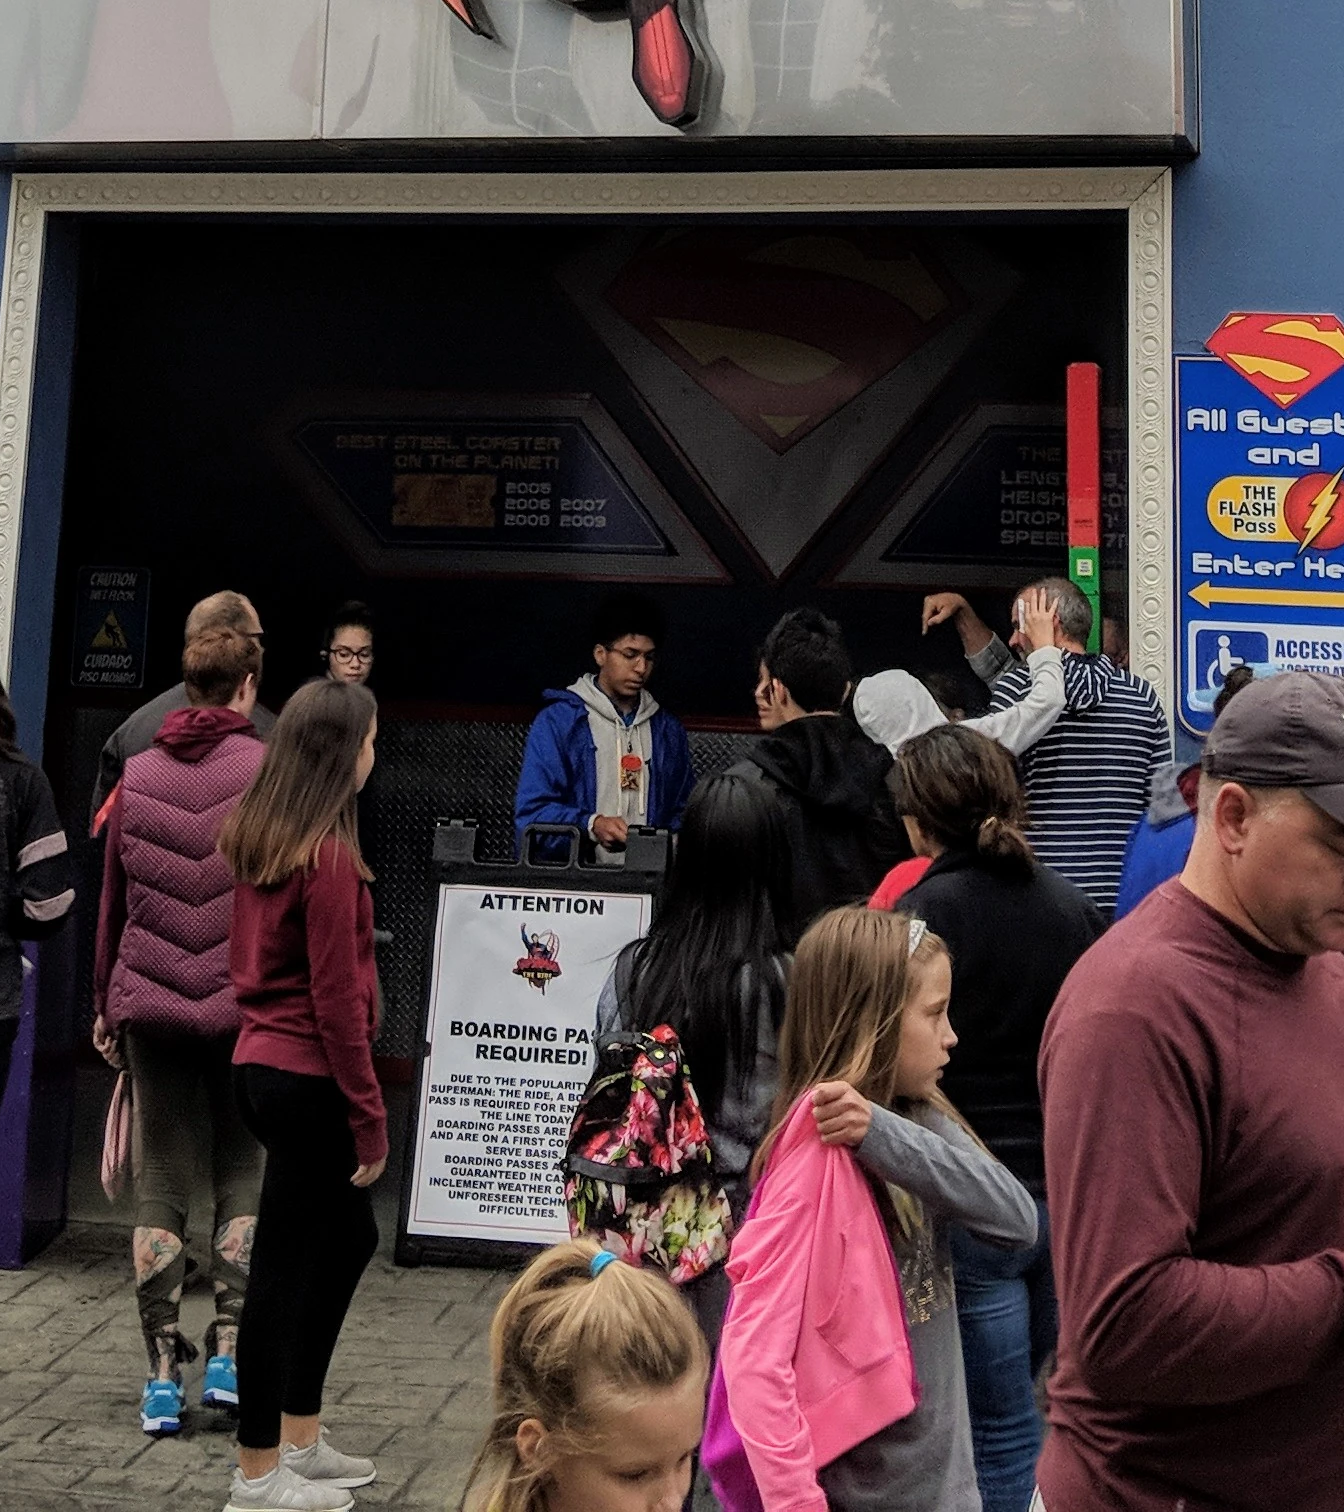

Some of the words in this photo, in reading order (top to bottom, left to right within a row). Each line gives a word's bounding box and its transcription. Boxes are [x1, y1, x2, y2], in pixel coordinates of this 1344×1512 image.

[1187, 408, 1226, 432] All
[394, 454, 422, 469] ON
[429, 455, 469, 469] THE
[1247, 442, 1320, 467] and
[504, 482, 552, 495] 2005
[1242, 485, 1276, 501] THE
[504, 498, 551, 511] 2006
[559, 498, 608, 512] 2007
[1000, 490, 1065, 506] HEIGH
[1219, 501, 1276, 518] FLASH
[1233, 518, 1276, 534] Pass
[1192, 553, 1296, 577] Enter
[90, 572, 138, 587] CAUTION
[84, 653, 133, 669] CUIDADO
[480, 893, 604, 915] ATTENTION
[450, 1020, 558, 1042] BOARDING
[564, 1028, 595, 1044] PA
[475, 1043, 587, 1066] REQUIRED!
[450, 1074, 473, 1084] DUE
[476, 1075, 491, 1085] TO
[494, 1076, 516, 1087] THE
[519, 1077, 588, 1091] POPULARITY
[430, 1084, 496, 1097] SUPERMAN:
[499, 1088, 521, 1099] THE
[524, 1090, 554, 1102] RIDE,
[556, 1092, 565, 1101] A
[428, 1095, 457, 1106] PASS
[459, 1097, 470, 1107] IS
[473, 1098, 531, 1111] REQUIRED
[534, 1102, 556, 1112] FOR
[480, 1110, 503, 1120] THE
[506, 1111, 532, 1122] LINE
[436, 1119, 495, 1132] BOARDING
[498, 1123, 540, 1135] PASSES
[543, 1126, 567, 1136] ARE
[429, 1131, 454, 1141] AND
[456, 1132, 479, 1142] ARE
[482, 1134, 499, 1144] ON
[501, 1135, 510, 1145] A
[513, 1136, 546, 1147] FIRST
[485, 1145, 522, 1157] SERVE
[525, 1148, 562, 1160] BASIS.
[444, 1154, 503, 1167] BOARDING
[506, 1159, 549, 1171] PASSES
[450, 1167, 527, 1181] GUARANTEED
[529, 1172, 542, 1182] IN
[429, 1177, 494, 1190] INCLEMENT
[497, 1181, 552, 1195] WEATHER
[448, 1190, 524, 1204] UNFORESEEN
[527, 1195, 566, 1207] TECHN
[478, 1204, 558, 1218] DIFFICULTIES.
